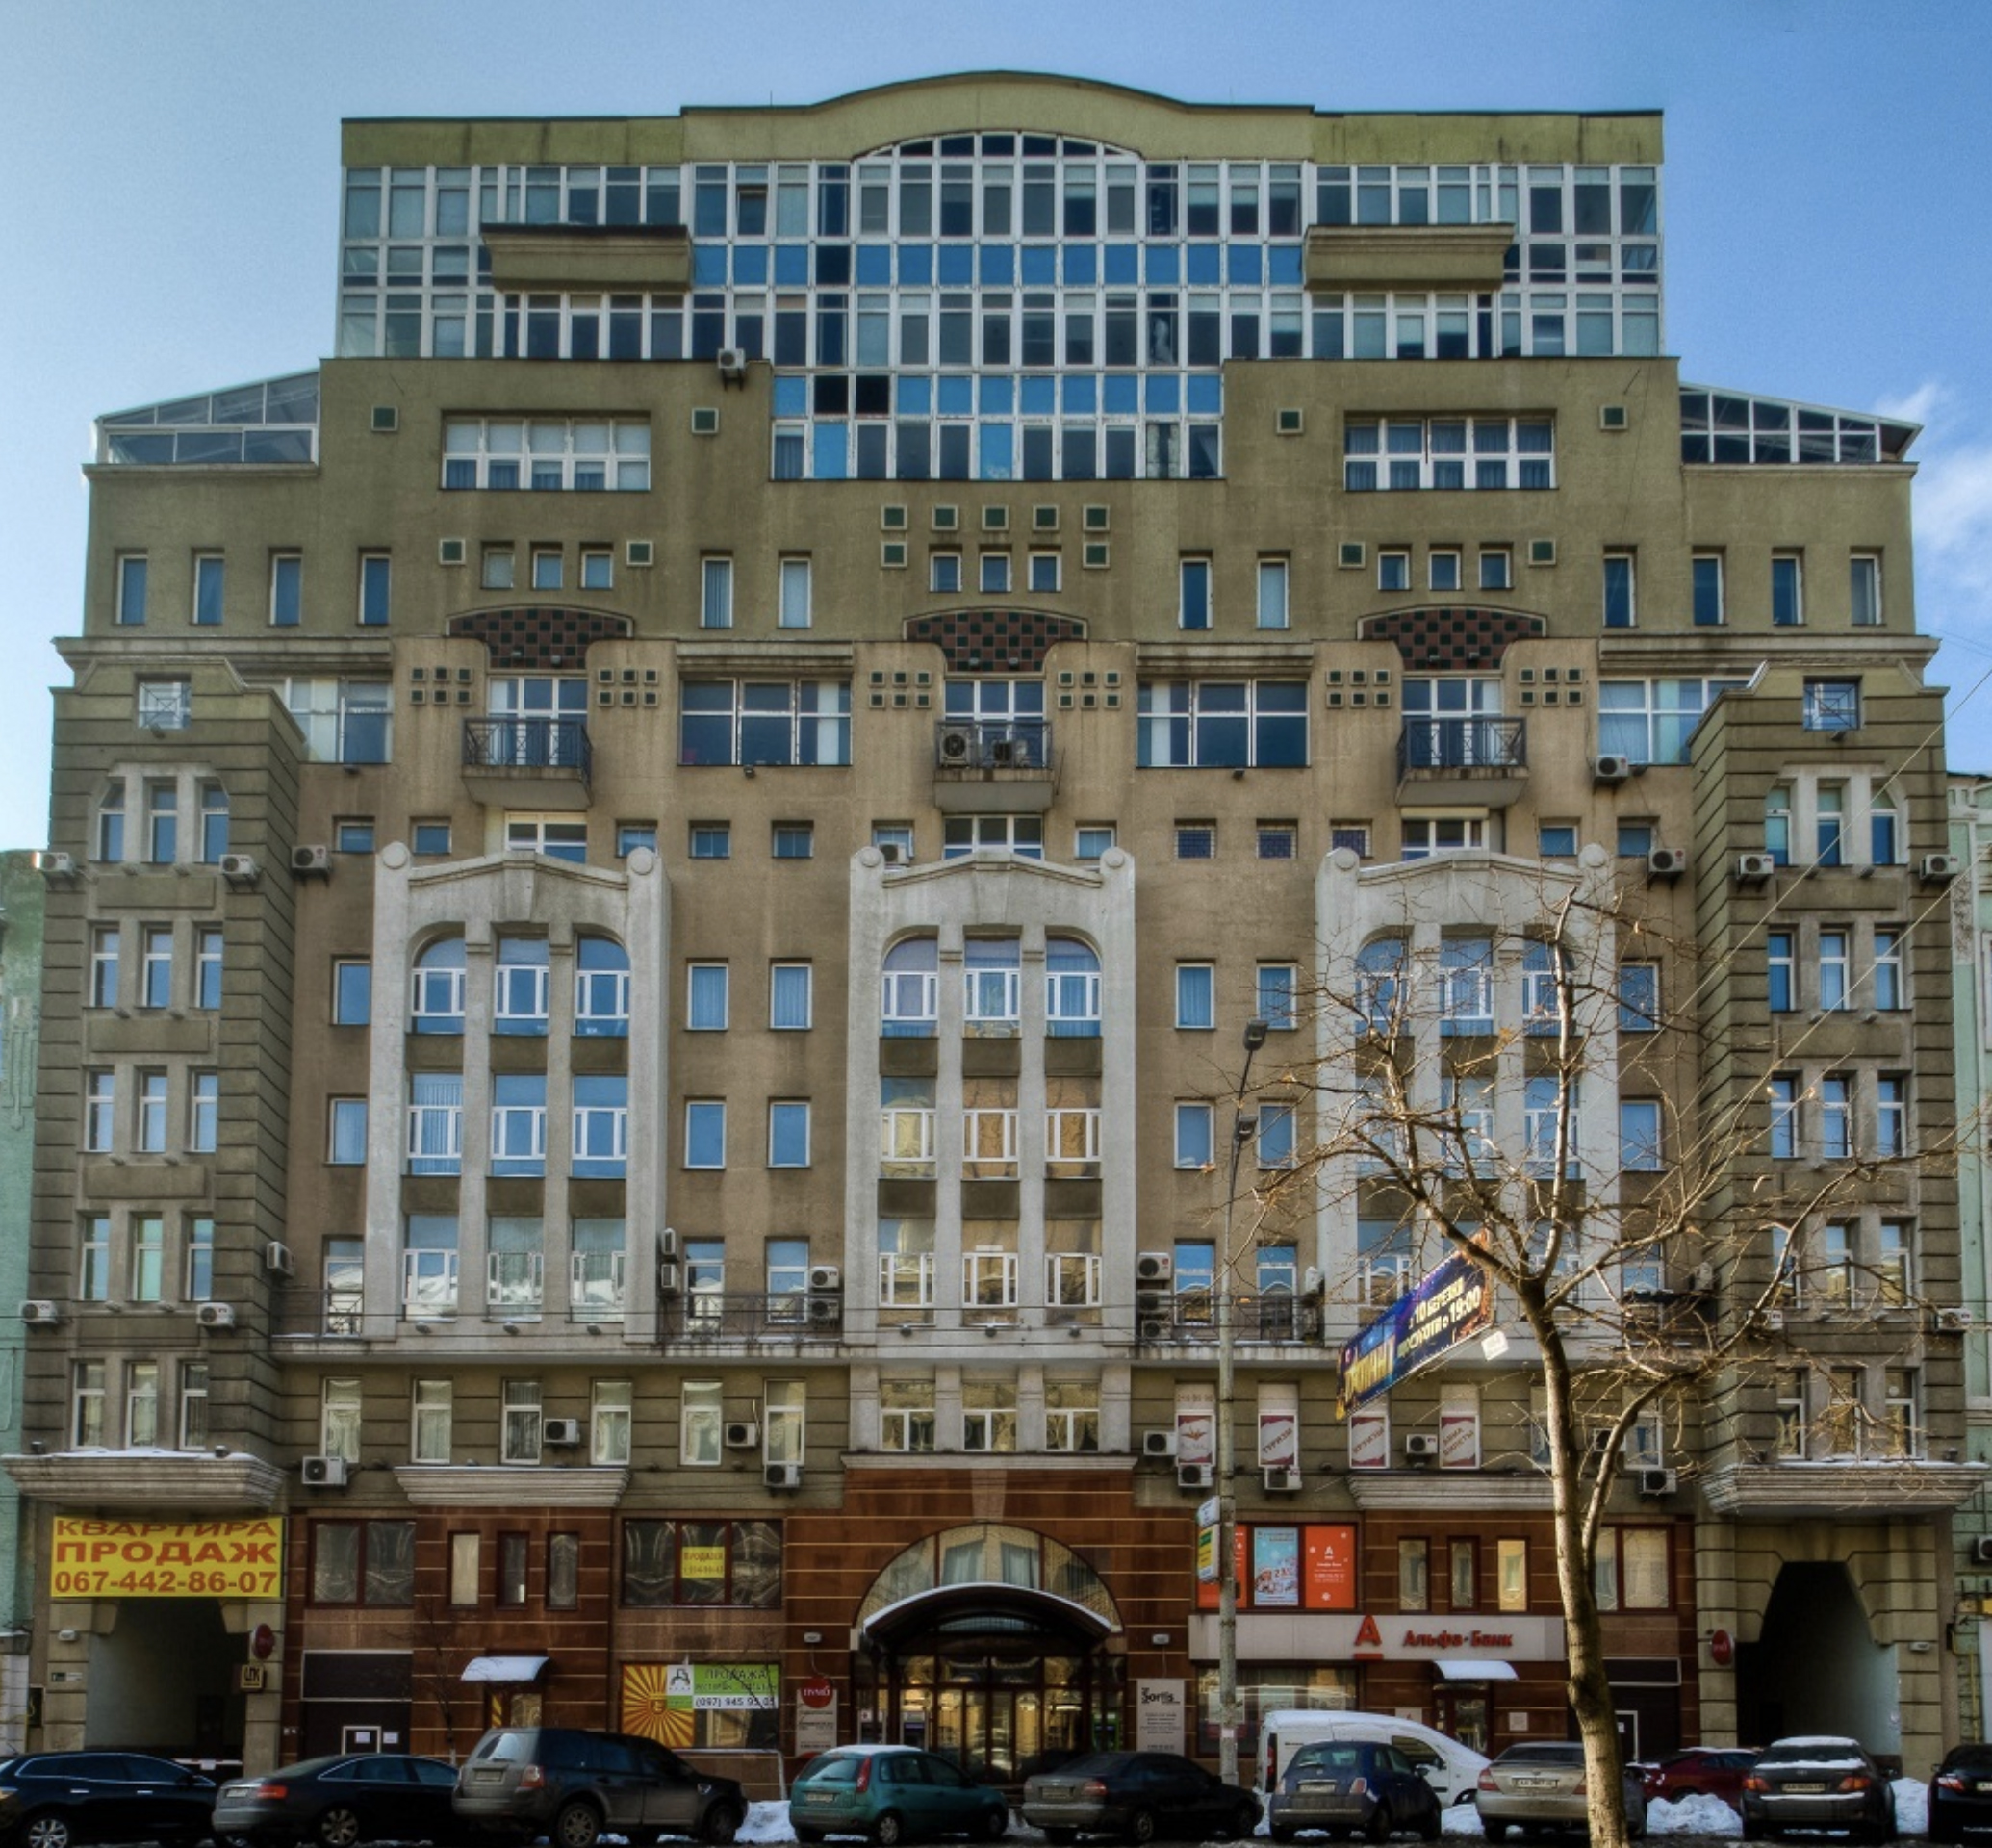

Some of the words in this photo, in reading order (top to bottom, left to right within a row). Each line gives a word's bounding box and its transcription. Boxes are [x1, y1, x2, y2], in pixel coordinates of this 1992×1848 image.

[1450, 1285, 1482, 1323] 19:00
[57, 1520, 277, 1536] КВАРТИРА
[56, 1542, 277, 1566] ПРОДАЖ
[55, 1570, 277, 1593] 067-442-86-07
